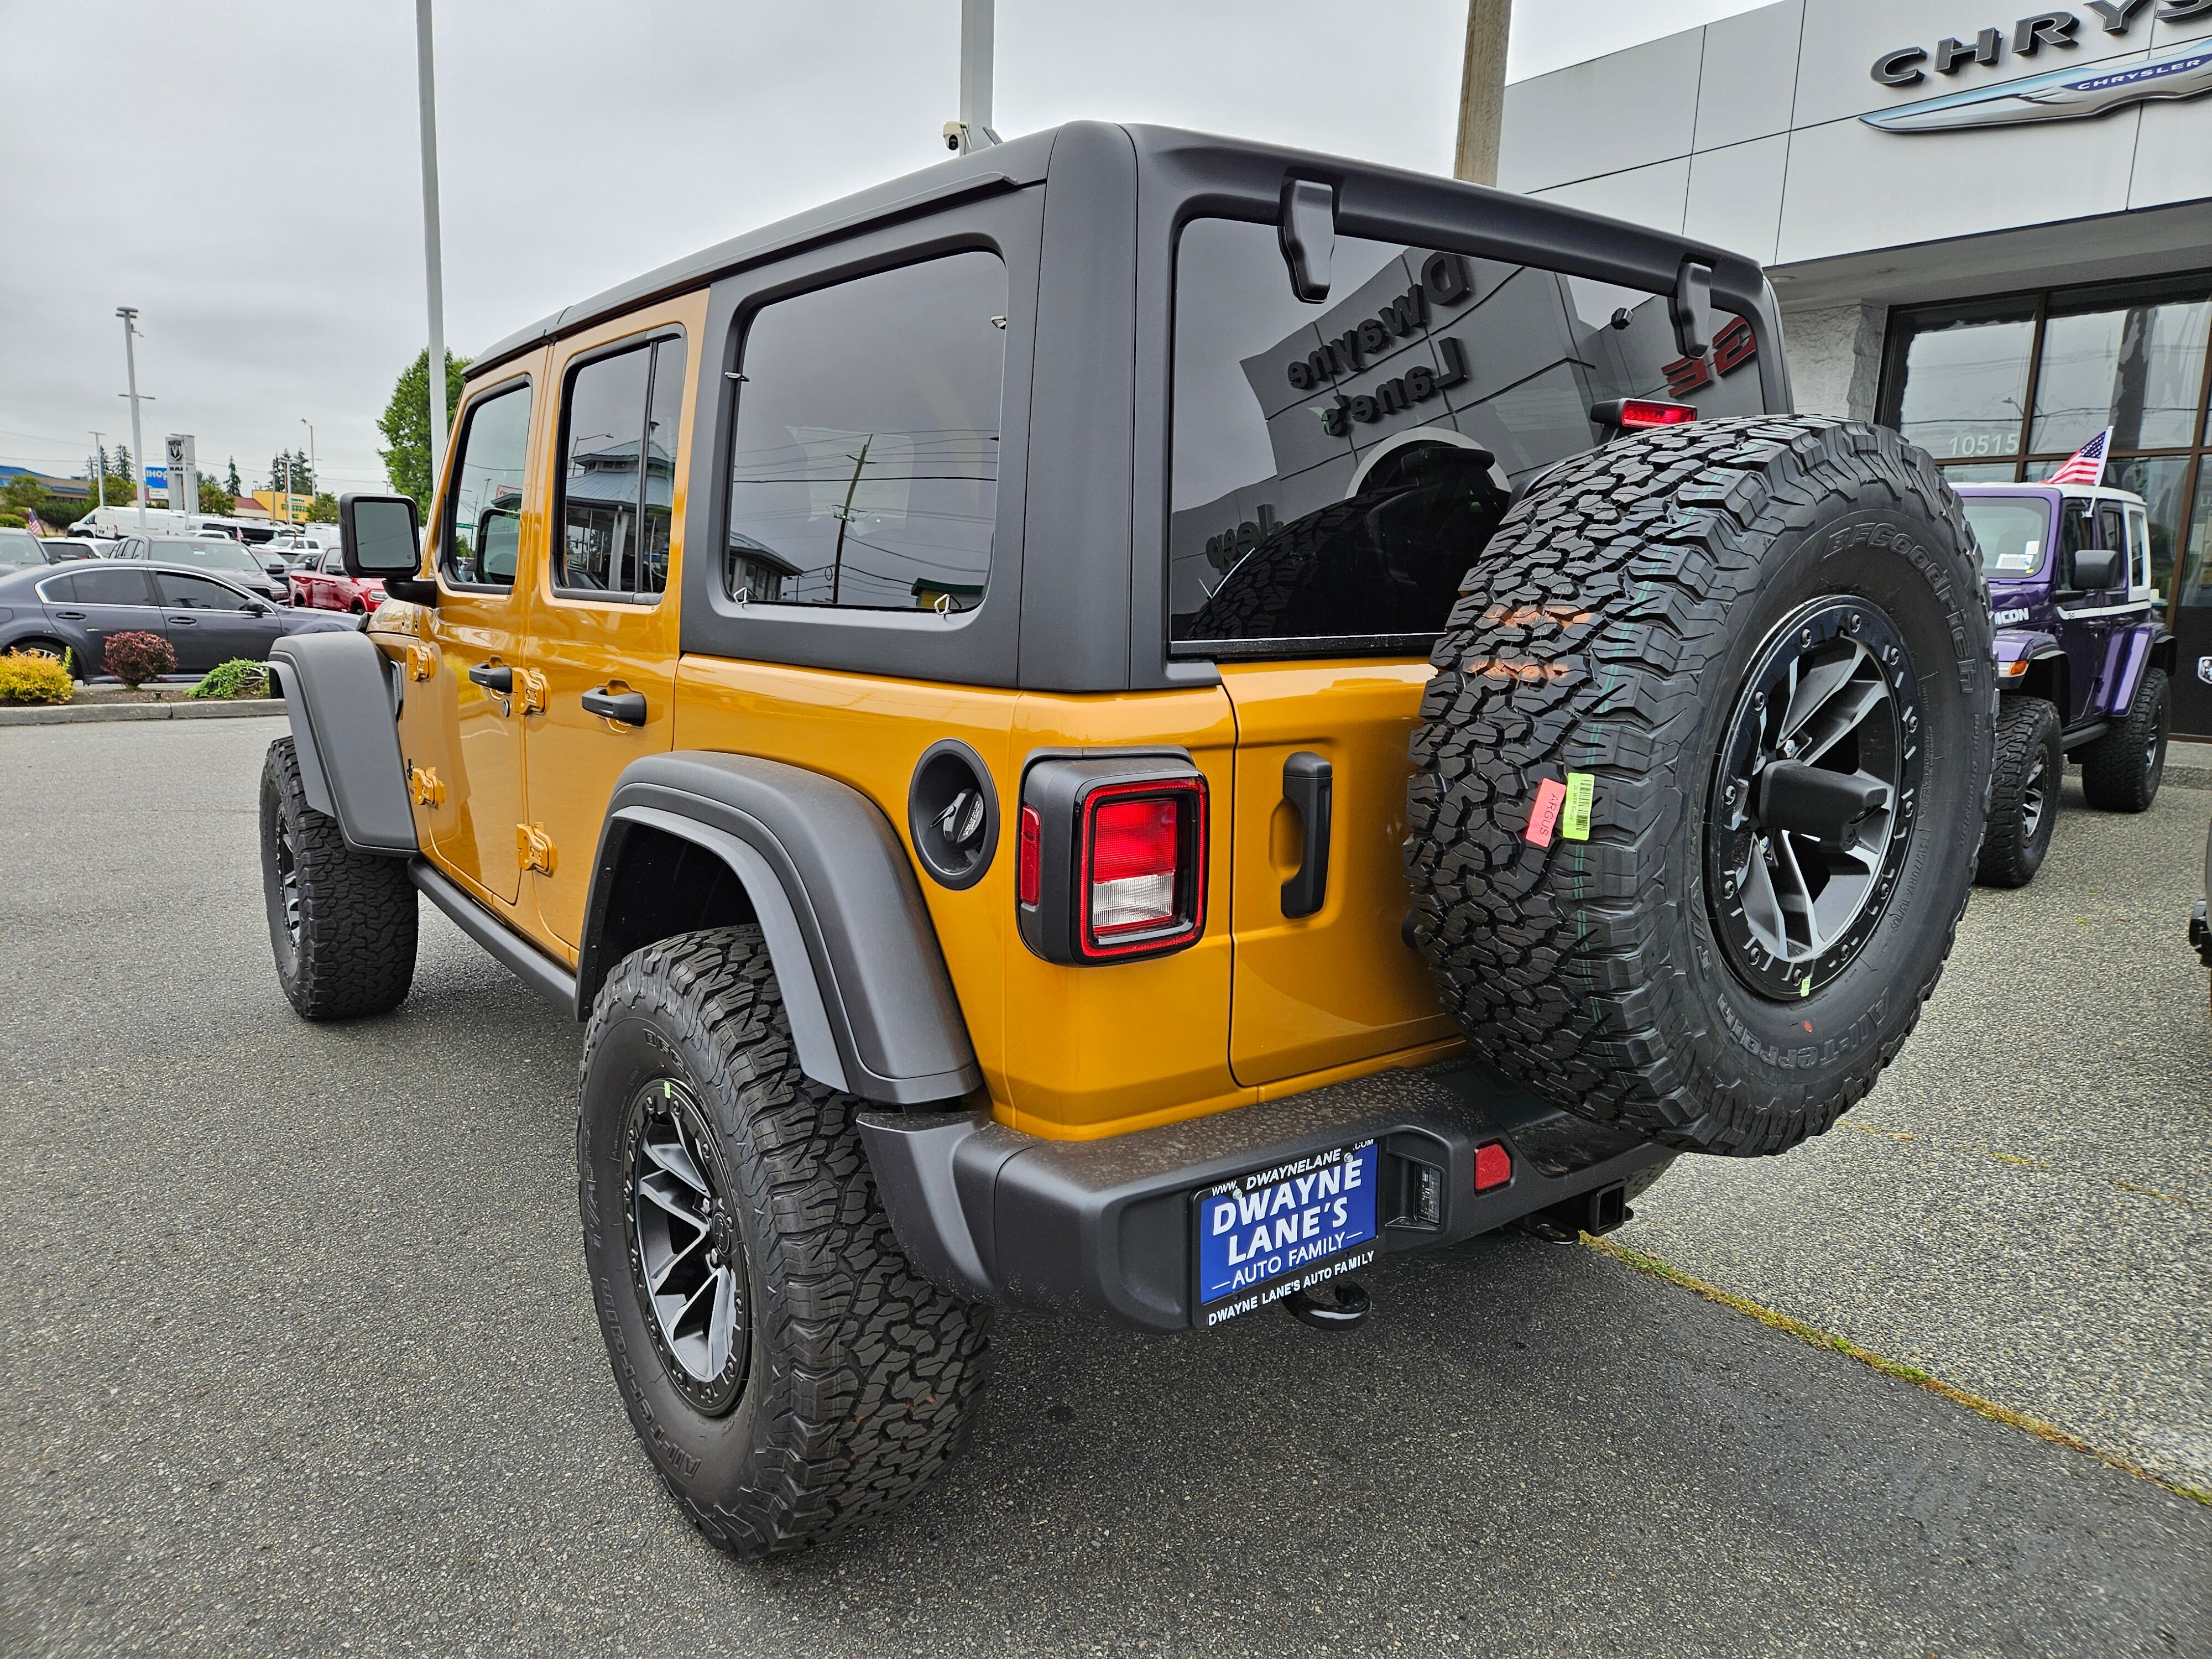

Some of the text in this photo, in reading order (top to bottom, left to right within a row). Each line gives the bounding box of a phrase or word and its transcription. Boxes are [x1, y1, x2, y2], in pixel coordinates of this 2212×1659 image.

[2078, 59, 2200, 90] CHRYSLER
[1950, 433, 2019, 456] 10515
[1823, 522, 1976, 694] BFGoodrich
[1994, 607, 2030, 625] ICON
[1540, 793, 1559, 836] ARGUS
[1568, 806, 1577, 821] Gray
[1717, 987, 1889, 1069] All-Terrain
[1246, 1148, 1342, 1190] DWAYNELANE
[1213, 1159, 1363, 1236] DWAYNE
[1228, 1197, 1348, 1266] LANE'S
[1232, 1232, 1345, 1289] AUTO FAMILY
[1208, 1250, 1375, 1326] DWAYNE LANE'S AUTO FAMILY
